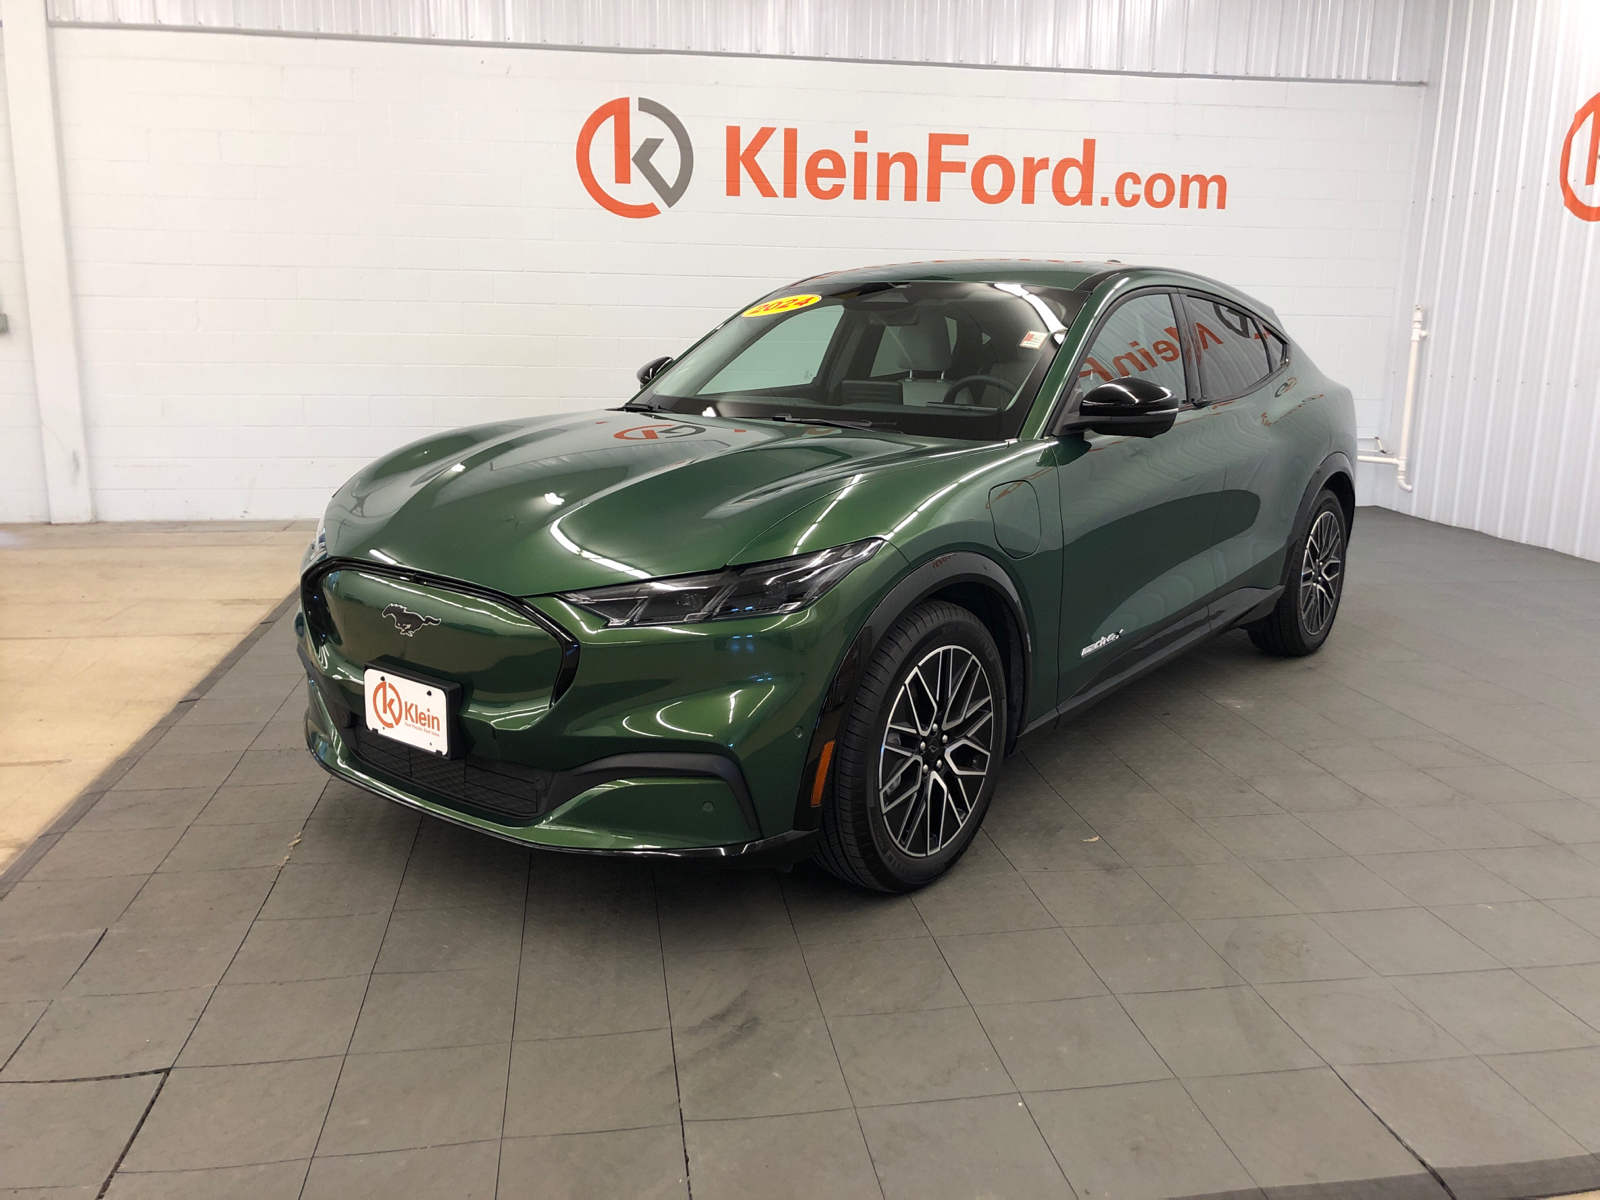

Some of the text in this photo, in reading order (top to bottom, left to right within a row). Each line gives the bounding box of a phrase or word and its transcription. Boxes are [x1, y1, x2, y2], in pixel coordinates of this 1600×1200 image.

[724, 124, 1228, 210] KleinFord.com
[745, 296, 815, 315] 2024
[404, 701, 441, 731] Klein
